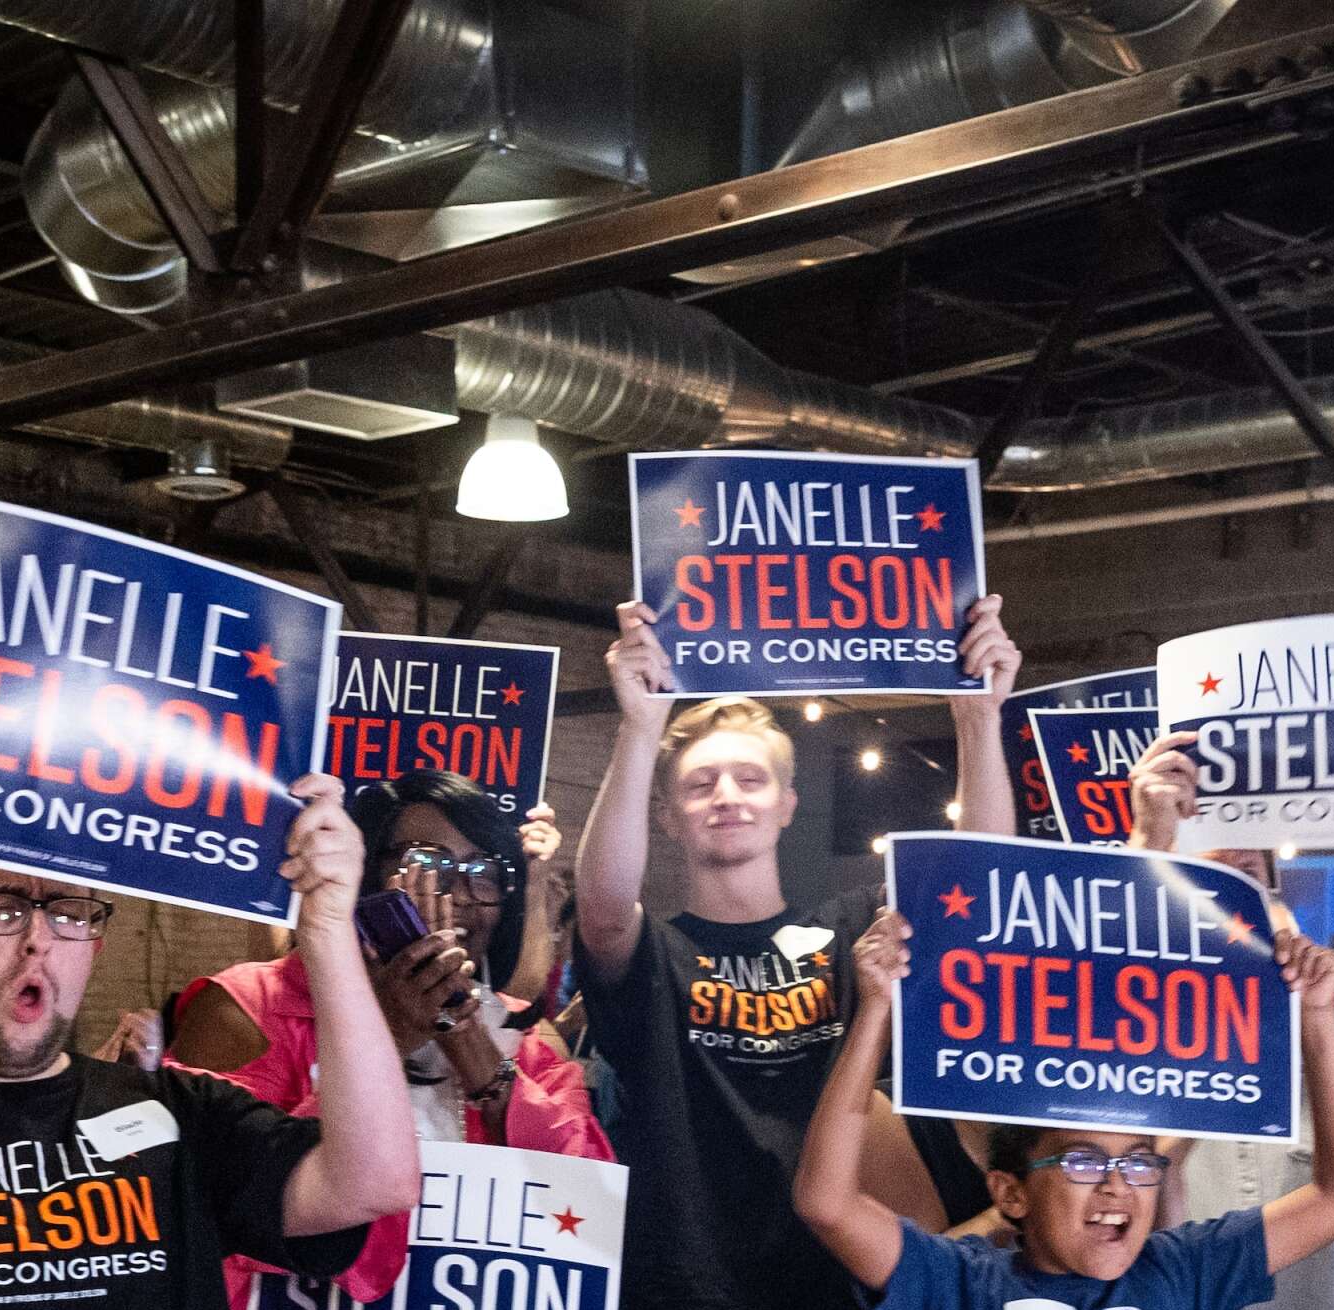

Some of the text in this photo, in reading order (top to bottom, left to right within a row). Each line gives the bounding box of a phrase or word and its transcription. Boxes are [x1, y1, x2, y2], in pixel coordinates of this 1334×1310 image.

[708, 480, 918, 549] JANELLE
[675, 554, 956, 633] STELSON
[676, 638, 958, 666] FOR CONGRESS
[327, 715, 522, 788] TELSON
[1028, 815, 1060, 835] FO
[1195, 798, 1268, 824] FOR
[977, 867, 1224, 964] JANELLE
[687, 1029, 735, 1049] FOR
[939, 948, 1260, 1064] STELSON
[936, 1048, 1262, 1103] FOR CONGRESS
[417, 1172, 551, 1252] ELLE
